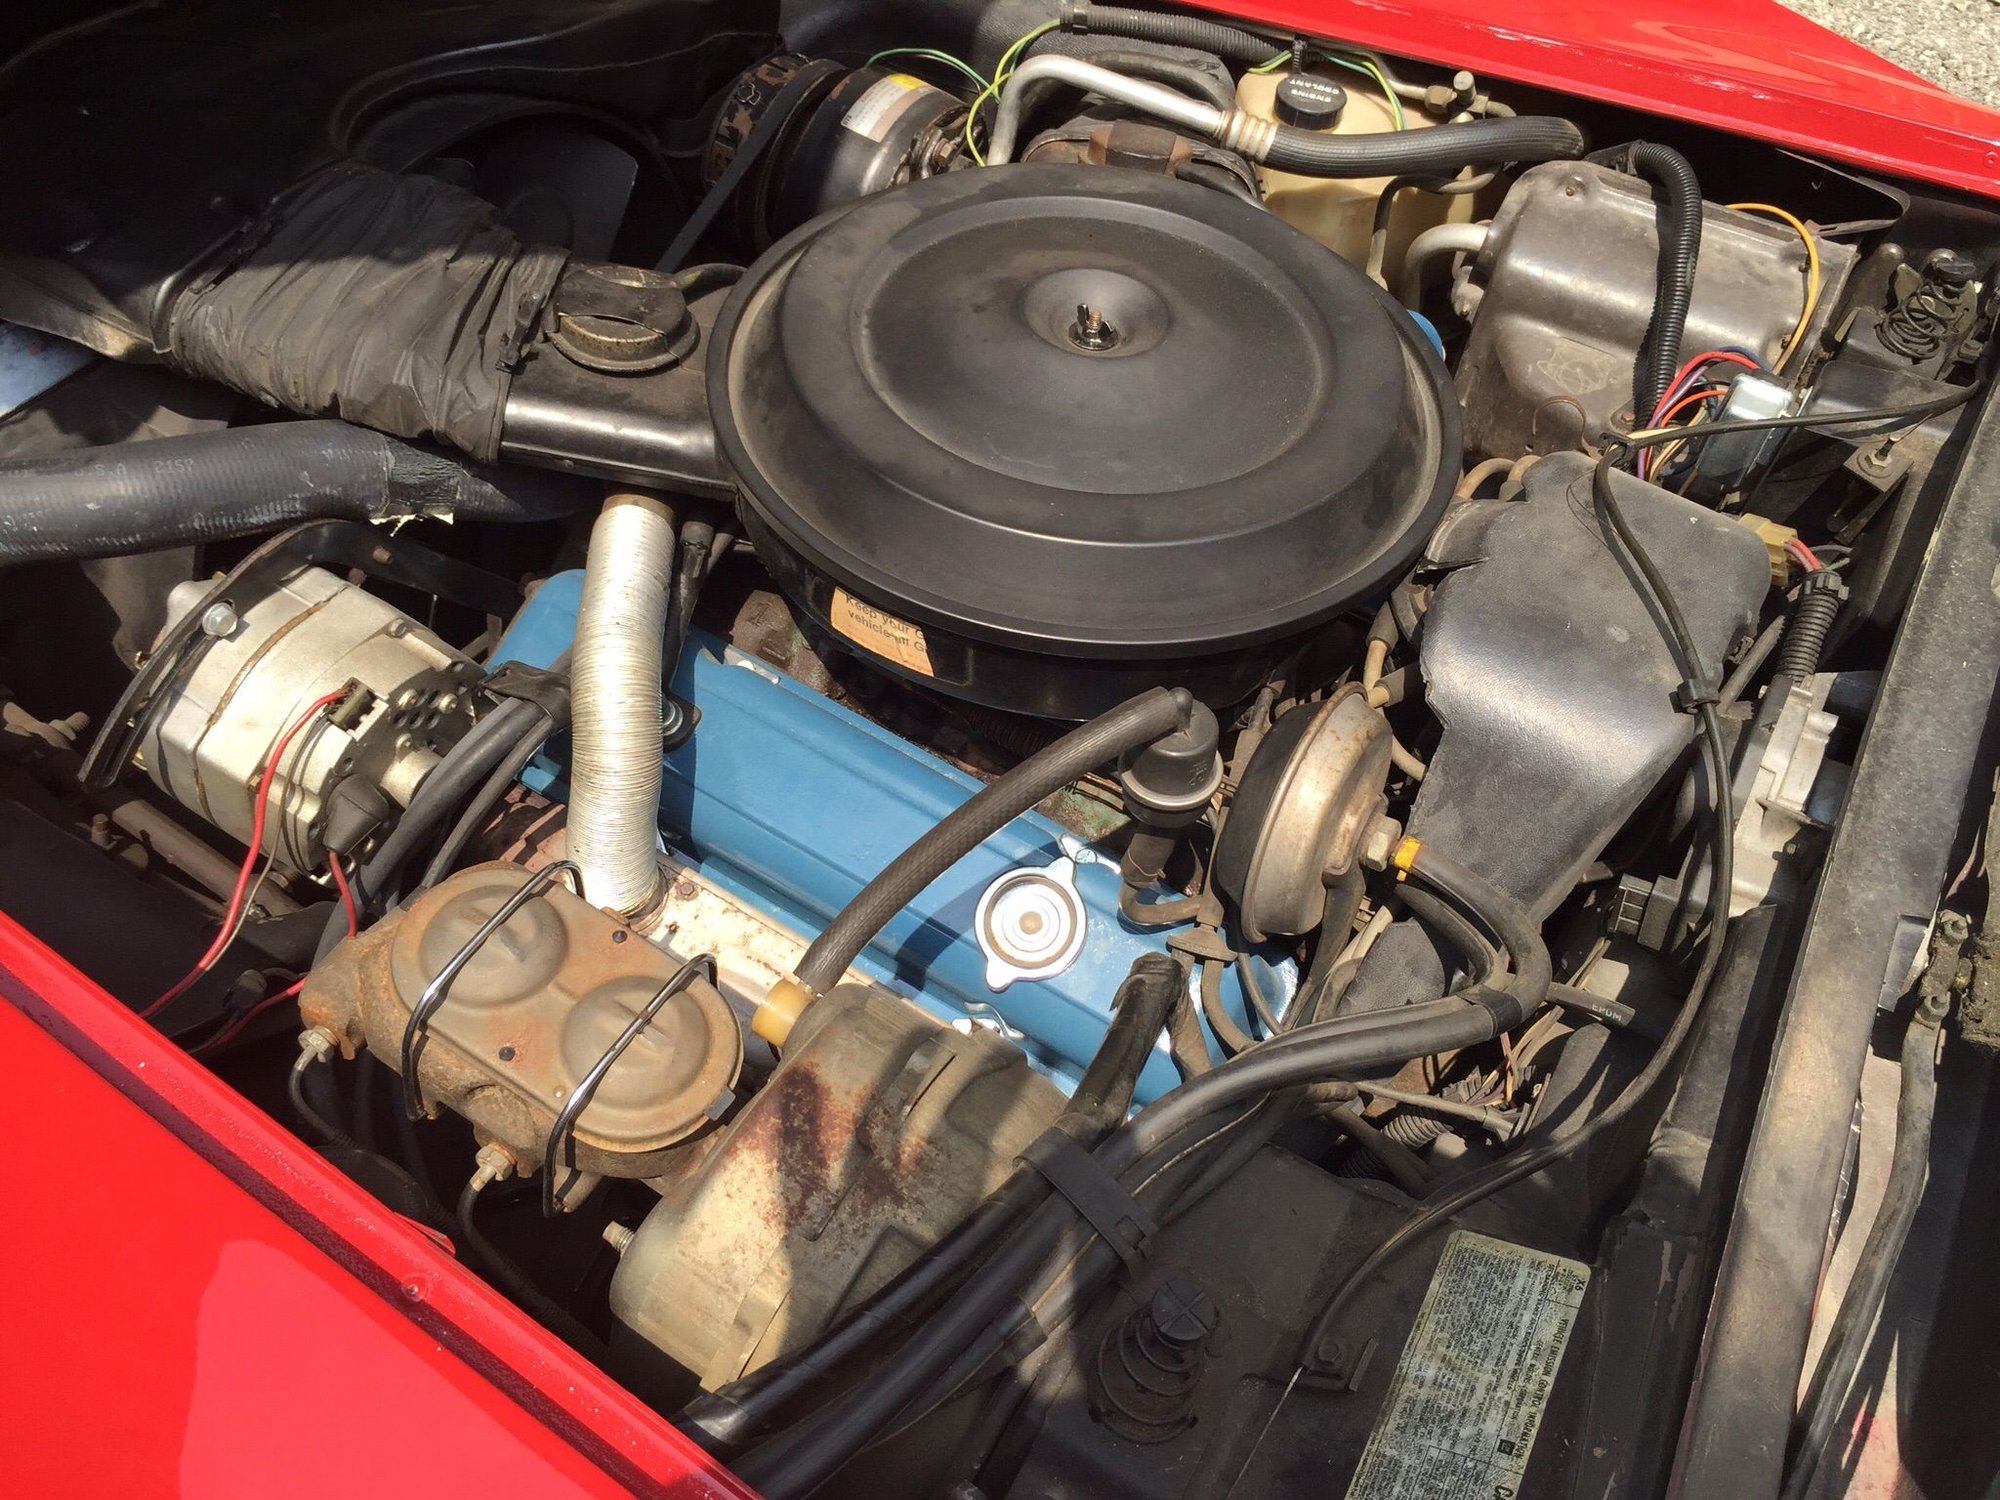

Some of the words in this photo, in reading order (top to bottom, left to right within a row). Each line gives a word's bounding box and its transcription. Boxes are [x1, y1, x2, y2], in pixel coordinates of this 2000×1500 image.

[1289, 77, 1340, 95] COOLANT
[1291, 88, 1331, 103] ENGINE
[845, 594, 877, 619] Keep
[882, 615, 909, 635] your
[847, 609, 890, 638] vehicle
[1574, 1278, 1586, 1291] X6
[1551, 1317, 1569, 1344] VEHICLE
[1540, 1344, 1560, 1377] EMISSION
[1529, 1378, 1549, 1409] CONTROL
[1512, 1410, 1538, 1459] INFORMATION
